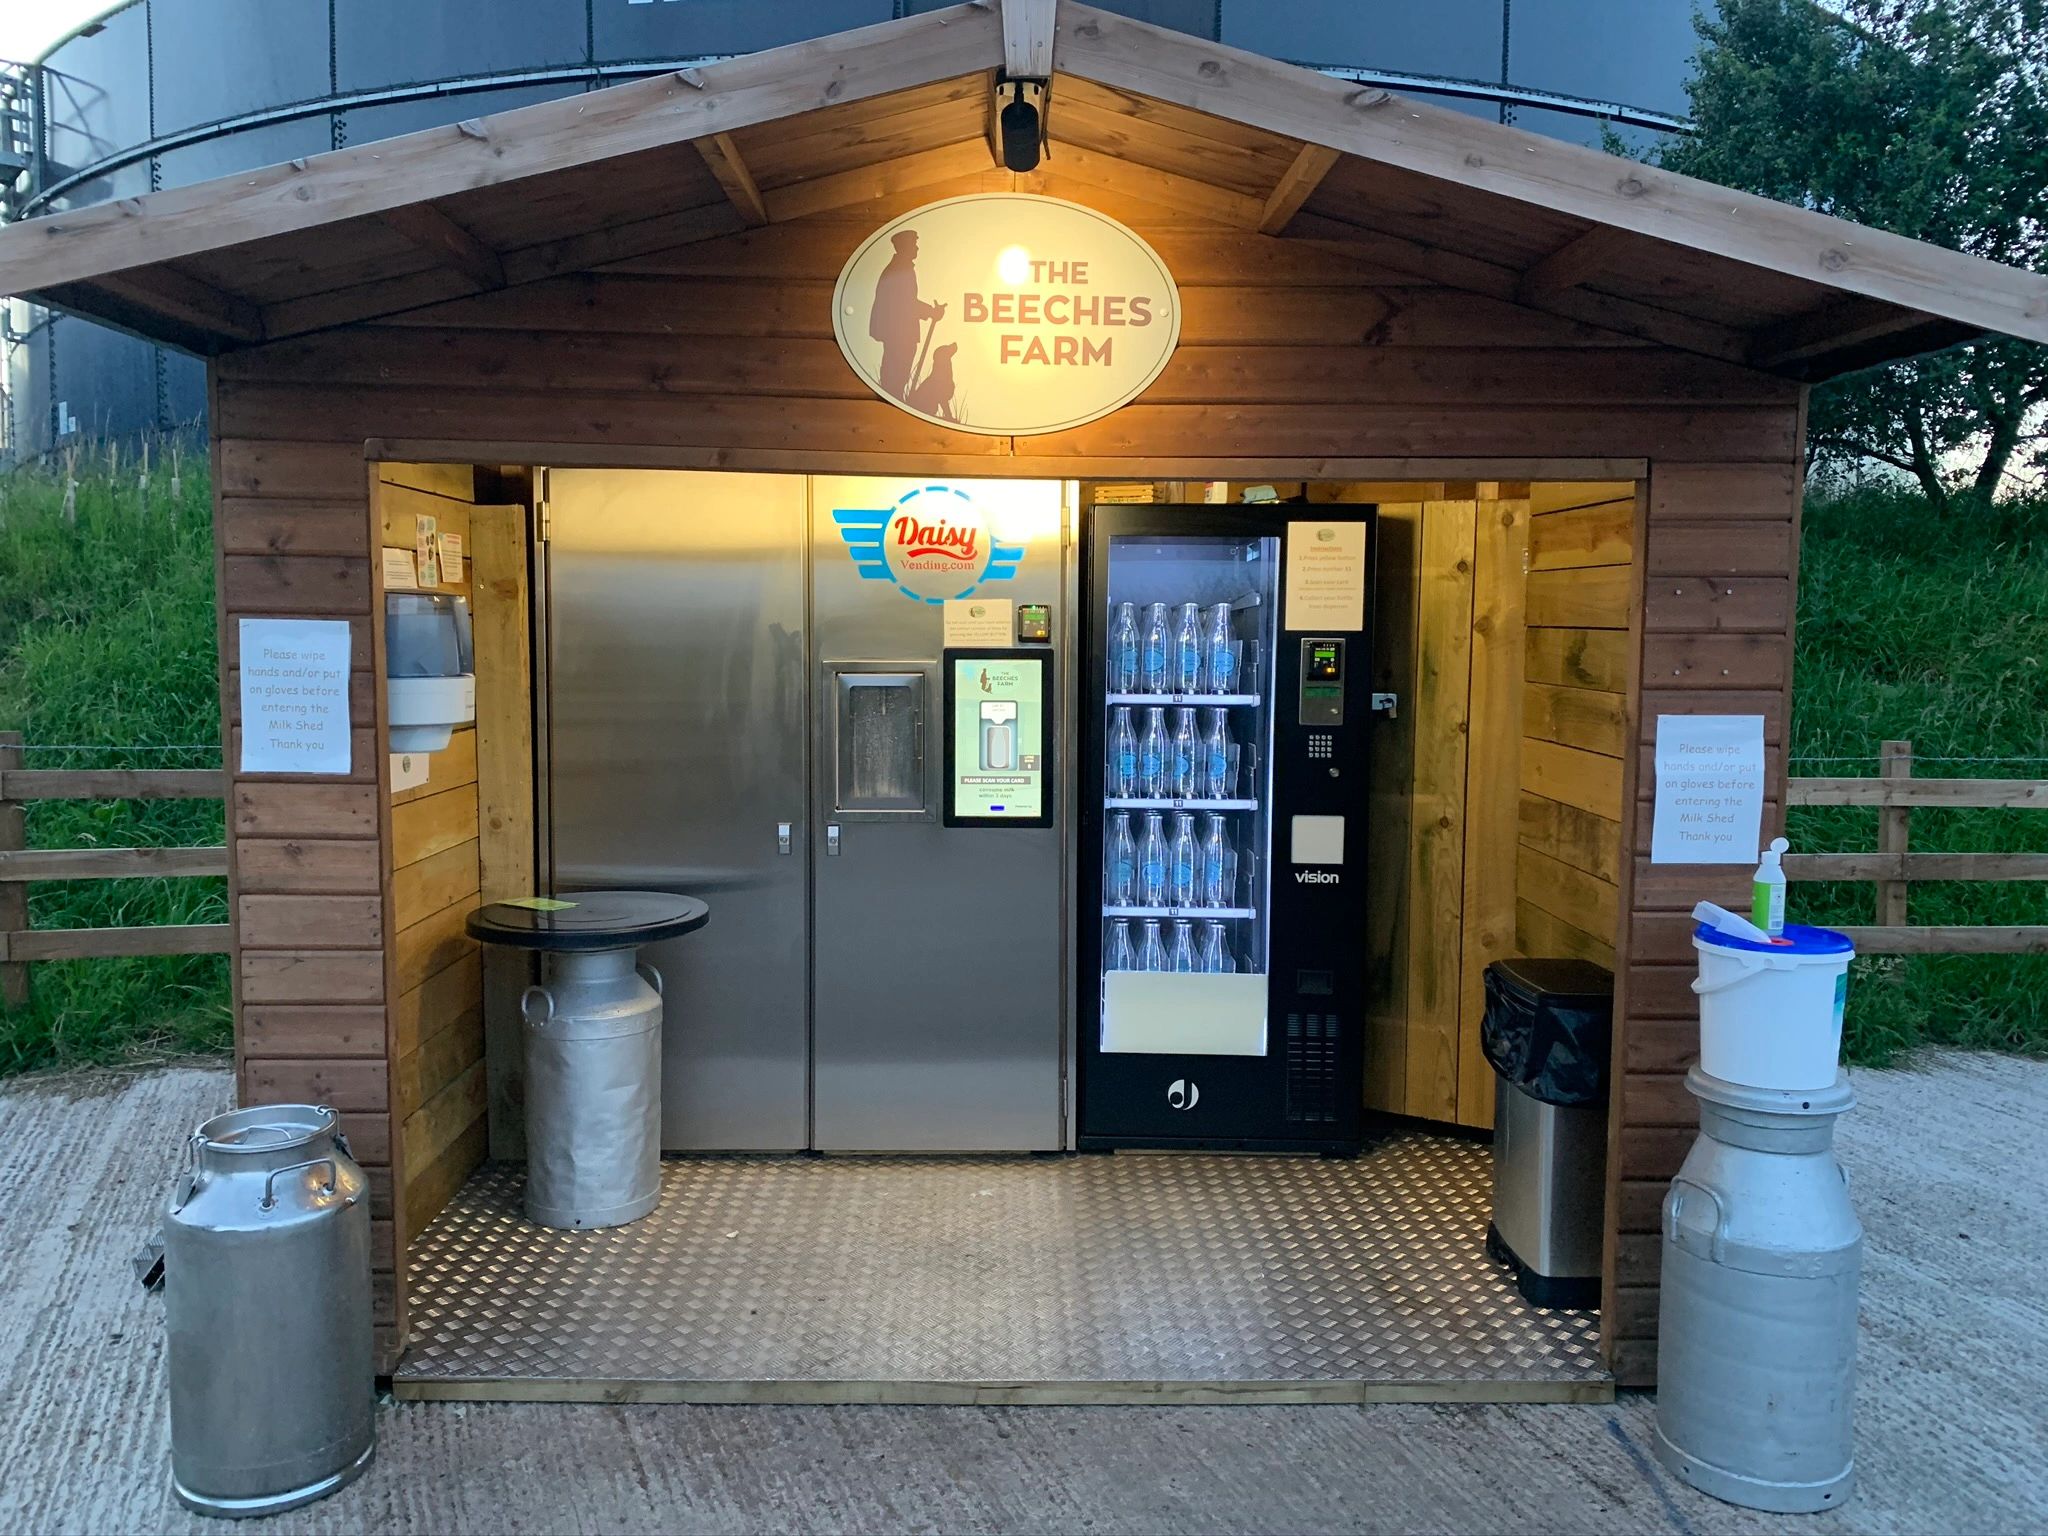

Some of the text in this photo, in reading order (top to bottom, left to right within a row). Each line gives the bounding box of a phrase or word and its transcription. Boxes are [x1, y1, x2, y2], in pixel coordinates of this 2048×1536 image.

[1029, 260, 1089, 285] THE
[963, 292, 1152, 327] BEECHES
[1000, 335, 1113, 367] FARM
[895, 516, 977, 556] Daisy
[900, 560, 975, 573] Vending.com
[263, 649, 326, 662] Please wipe
[248, 666, 341, 681] hands and/or put
[249, 685, 340, 698] on gloves before
[261, 703, 329, 715] entering the
[269, 720, 324, 731] Milk Shed
[270, 738, 325, 752] Thank you
[1679, 743, 1741, 757] Please wipe
[1664, 761, 1757, 774] hands and/or put
[1665, 779, 1756, 791] on gloves before
[1674, 796, 1743, 808] entering the
[1680, 813, 1735, 823] Milk Shed
[1680, 831, 1733, 843] Thank you
[1295, 869, 1340, 884] vision
